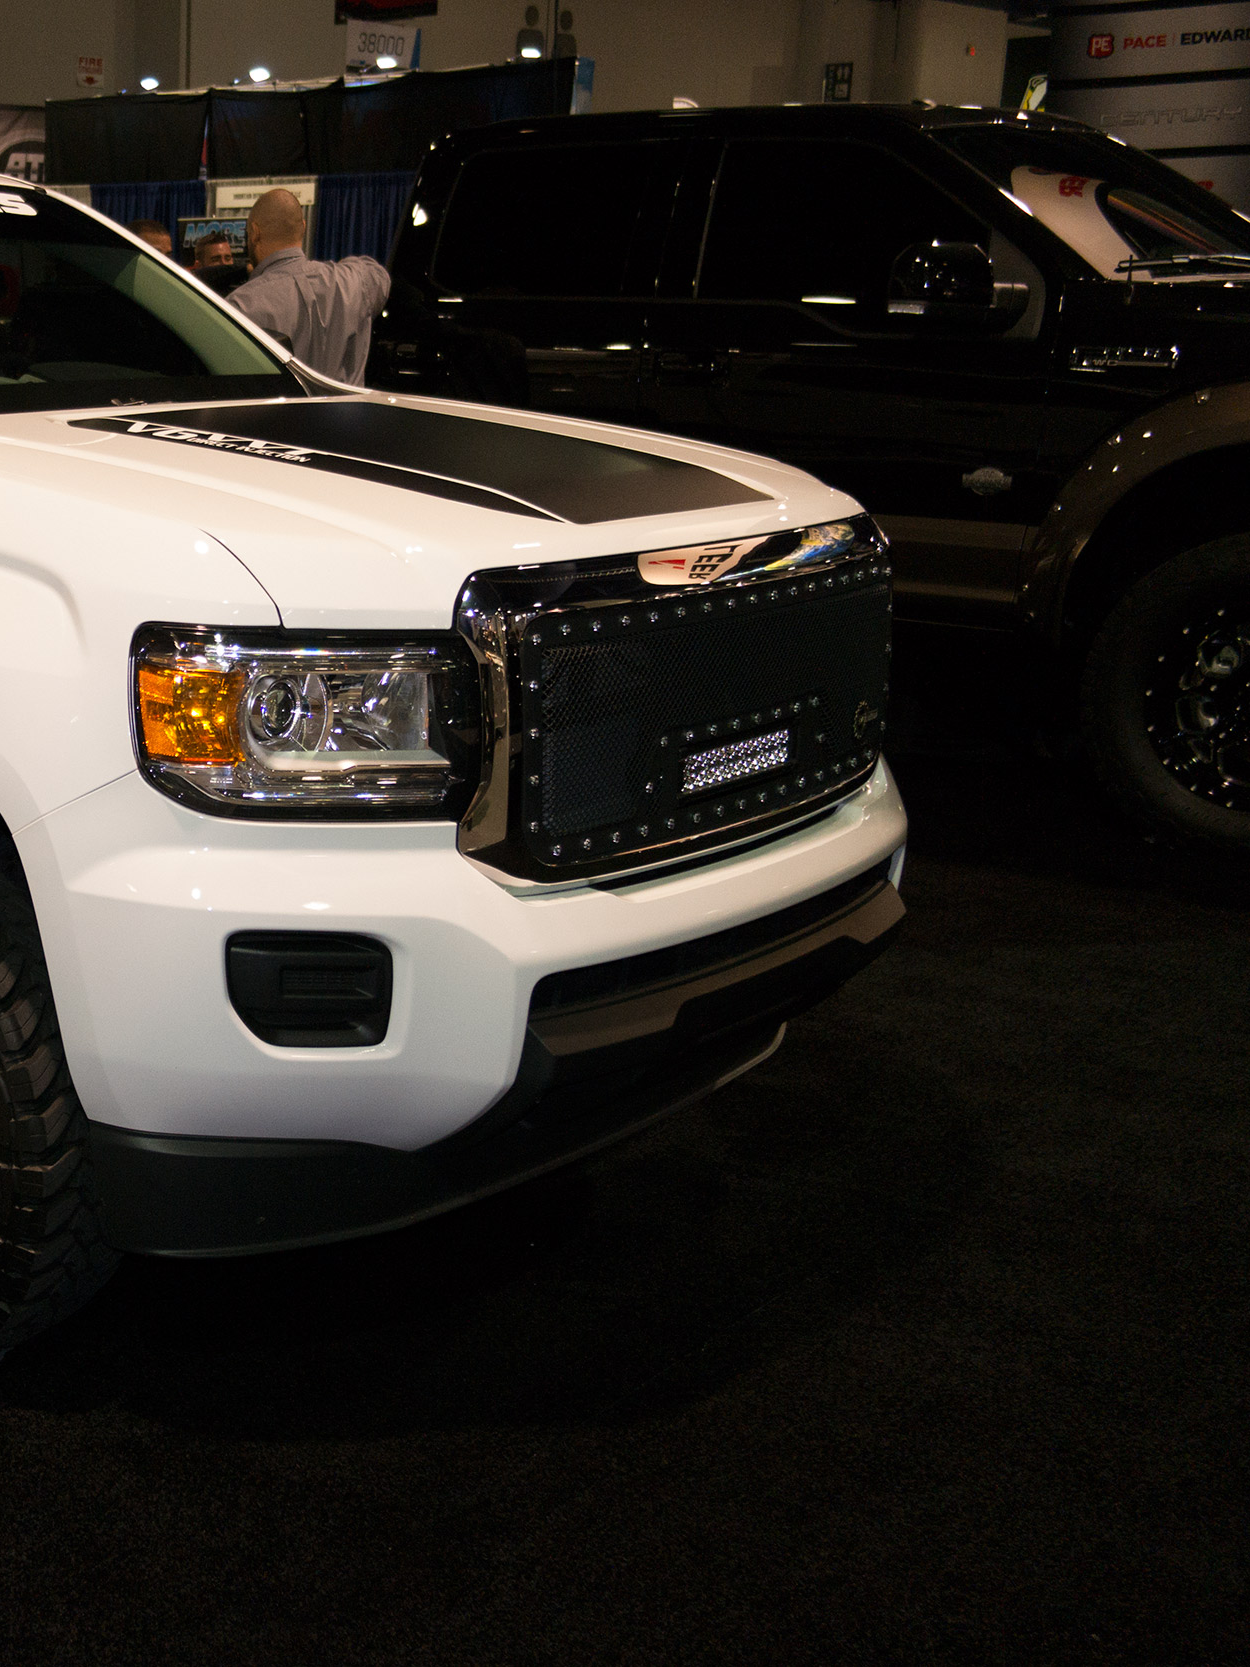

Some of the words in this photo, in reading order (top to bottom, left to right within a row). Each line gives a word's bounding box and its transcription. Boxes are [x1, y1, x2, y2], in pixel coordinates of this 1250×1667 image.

[357, 32, 405, 56] 38000
[1123, 35, 1167, 50] PACE
[1100, 106, 1242, 128] CENTURY
[126, 421, 199, 441] V6
[188, 437, 237, 450] DIRECT
[236, 445, 312, 463] INJECTION
